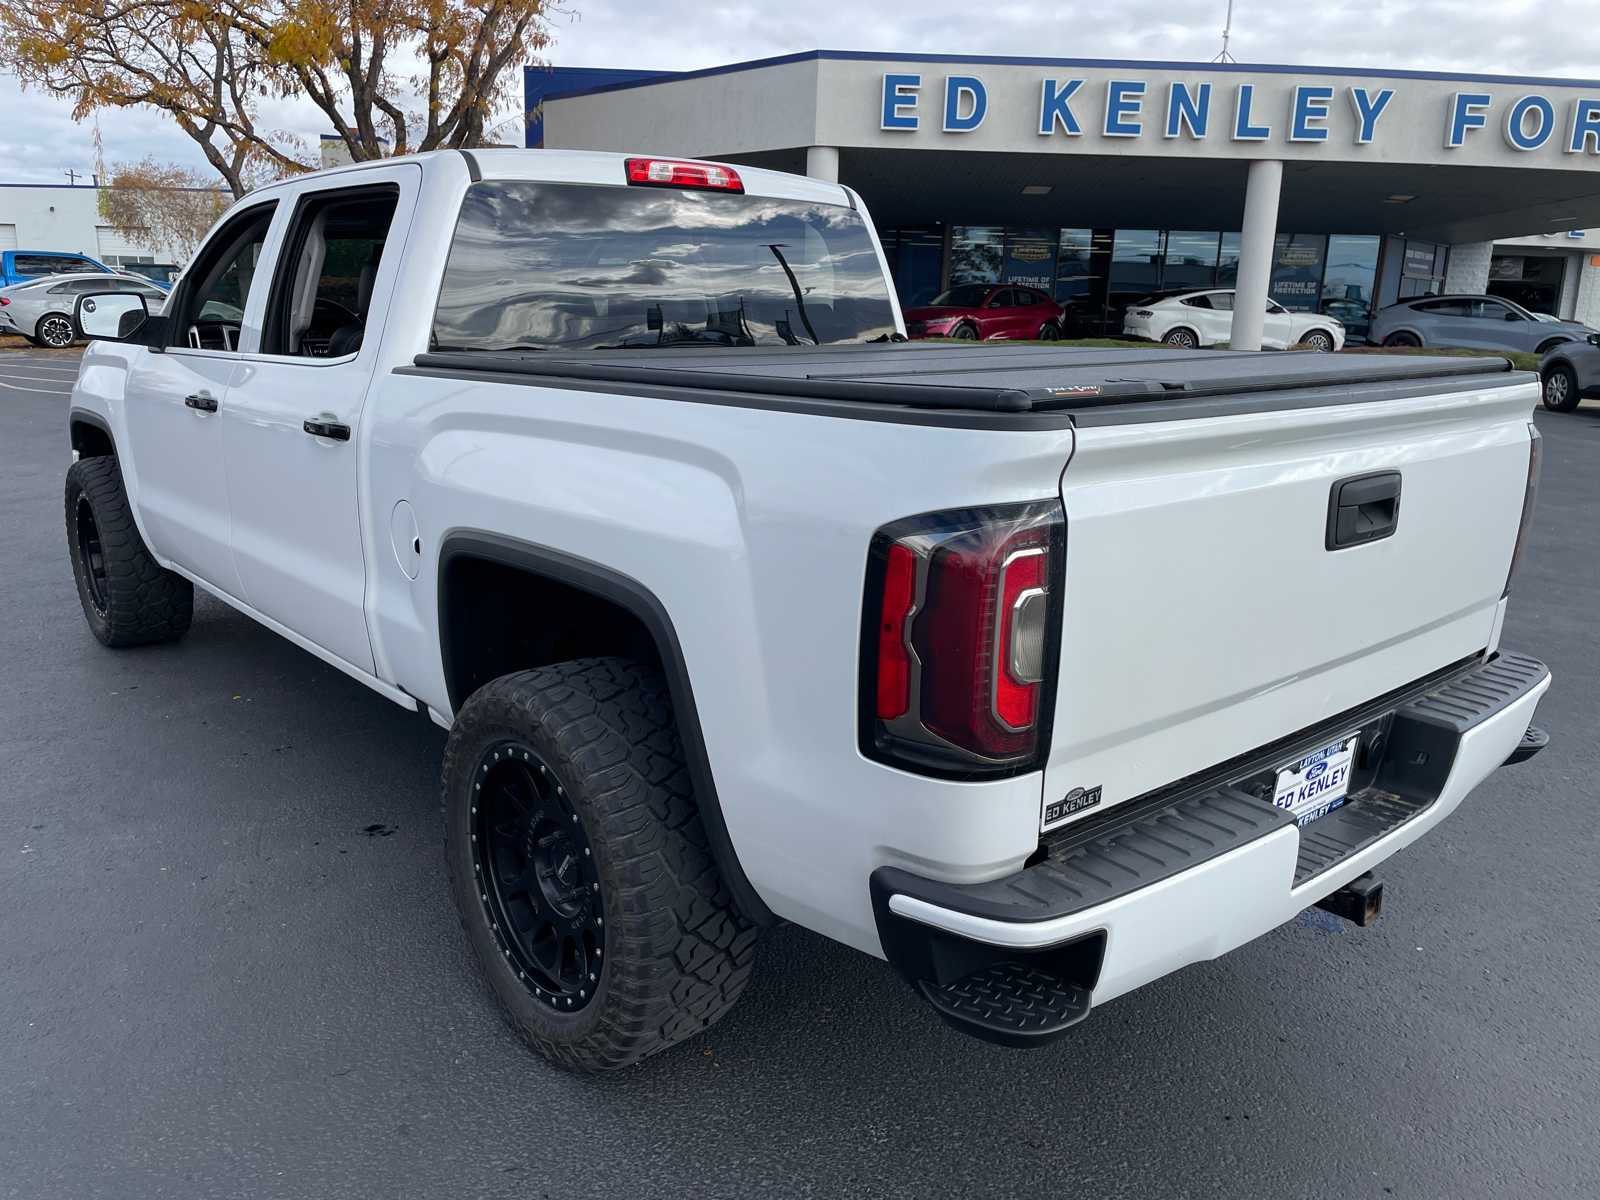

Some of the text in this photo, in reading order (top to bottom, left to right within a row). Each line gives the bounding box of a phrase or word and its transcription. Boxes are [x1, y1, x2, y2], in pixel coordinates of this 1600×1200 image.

[880, 73, 1600, 154] ED KENLEY FOR
[1046, 790, 1101, 820] ED KENLEY
[1276, 791, 1295, 809] ED
[1297, 765, 1348, 803] KENLEY
[1298, 803, 1332, 828] KENLEY
